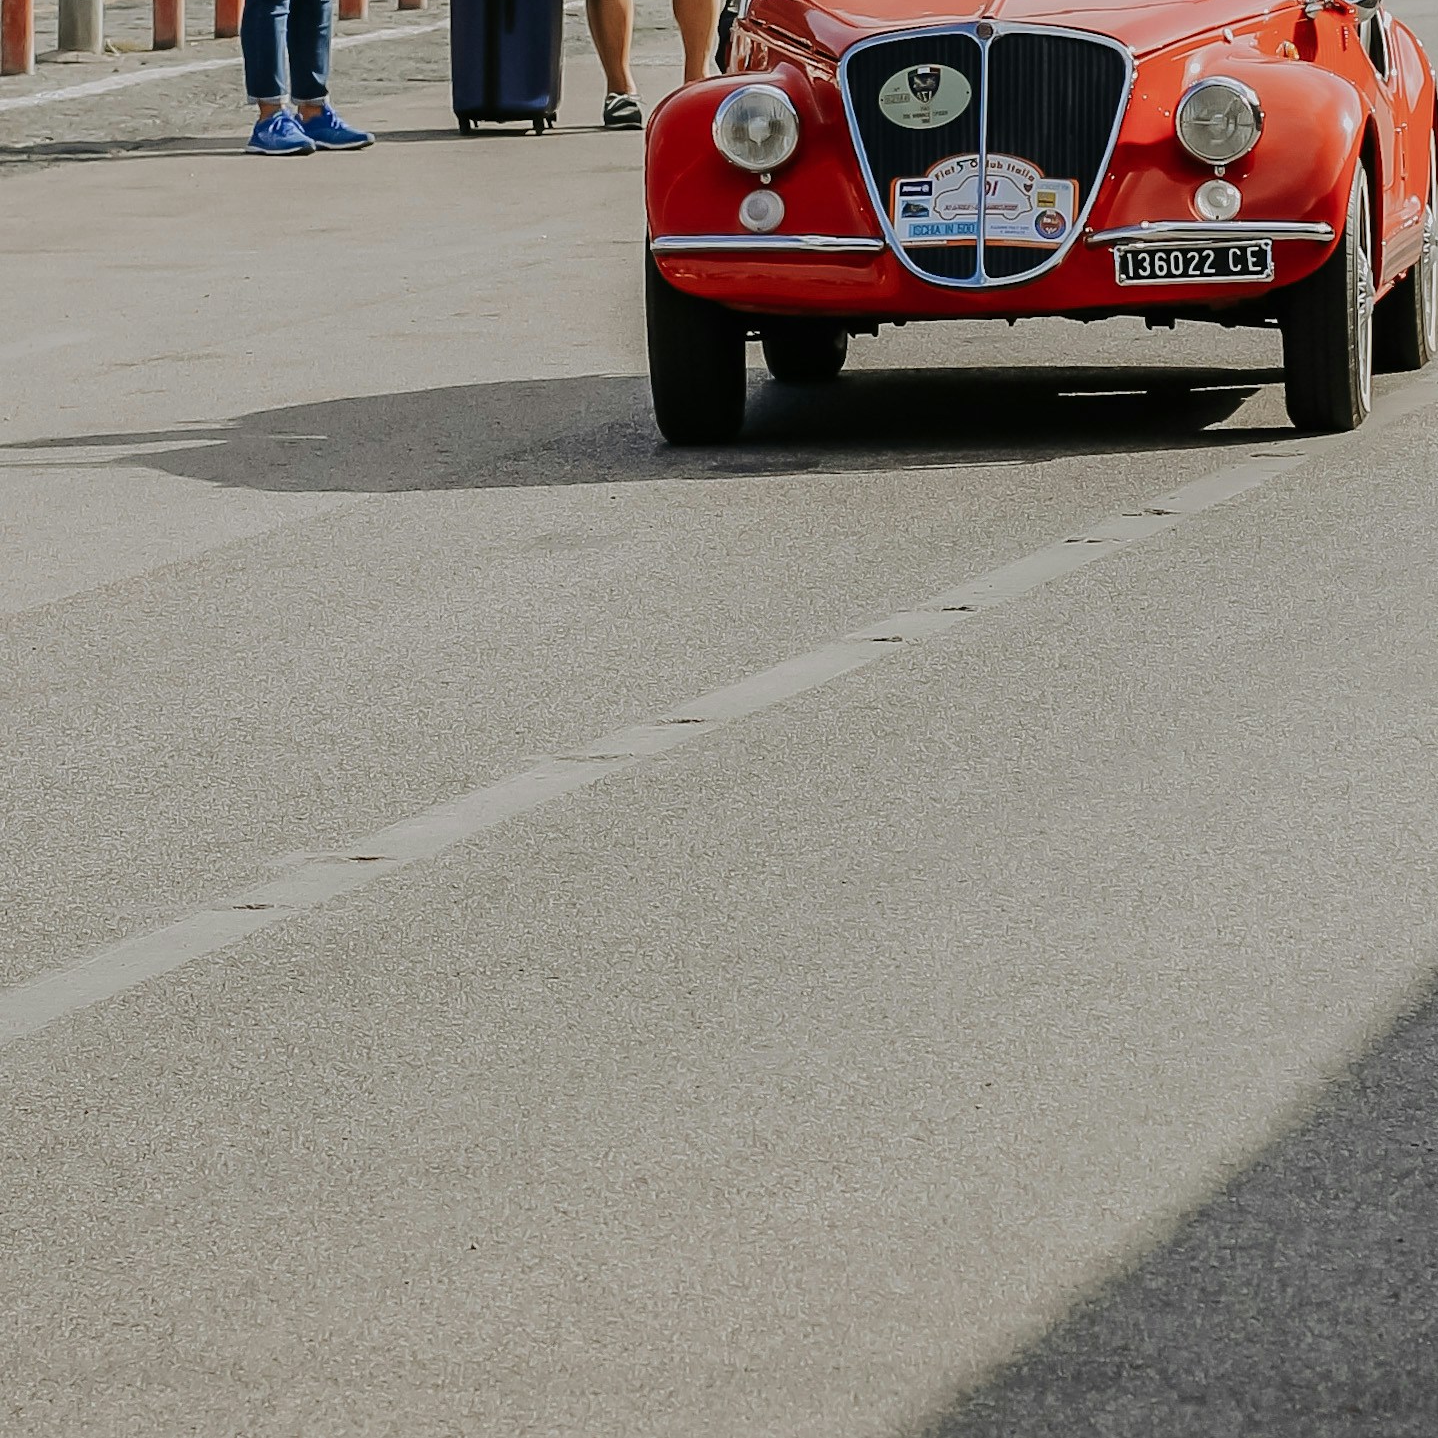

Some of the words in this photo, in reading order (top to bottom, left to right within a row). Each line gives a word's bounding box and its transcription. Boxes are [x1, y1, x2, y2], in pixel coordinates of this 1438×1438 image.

[935, 166, 955, 182] Fiat
[1007, 162, 1036, 182] Italia
[913, 225, 942, 237] ISCHIA
[945, 224, 954, 236] IN
[1126, 249, 1216, 278] 136022
[1228, 246, 1262, 272] CE
